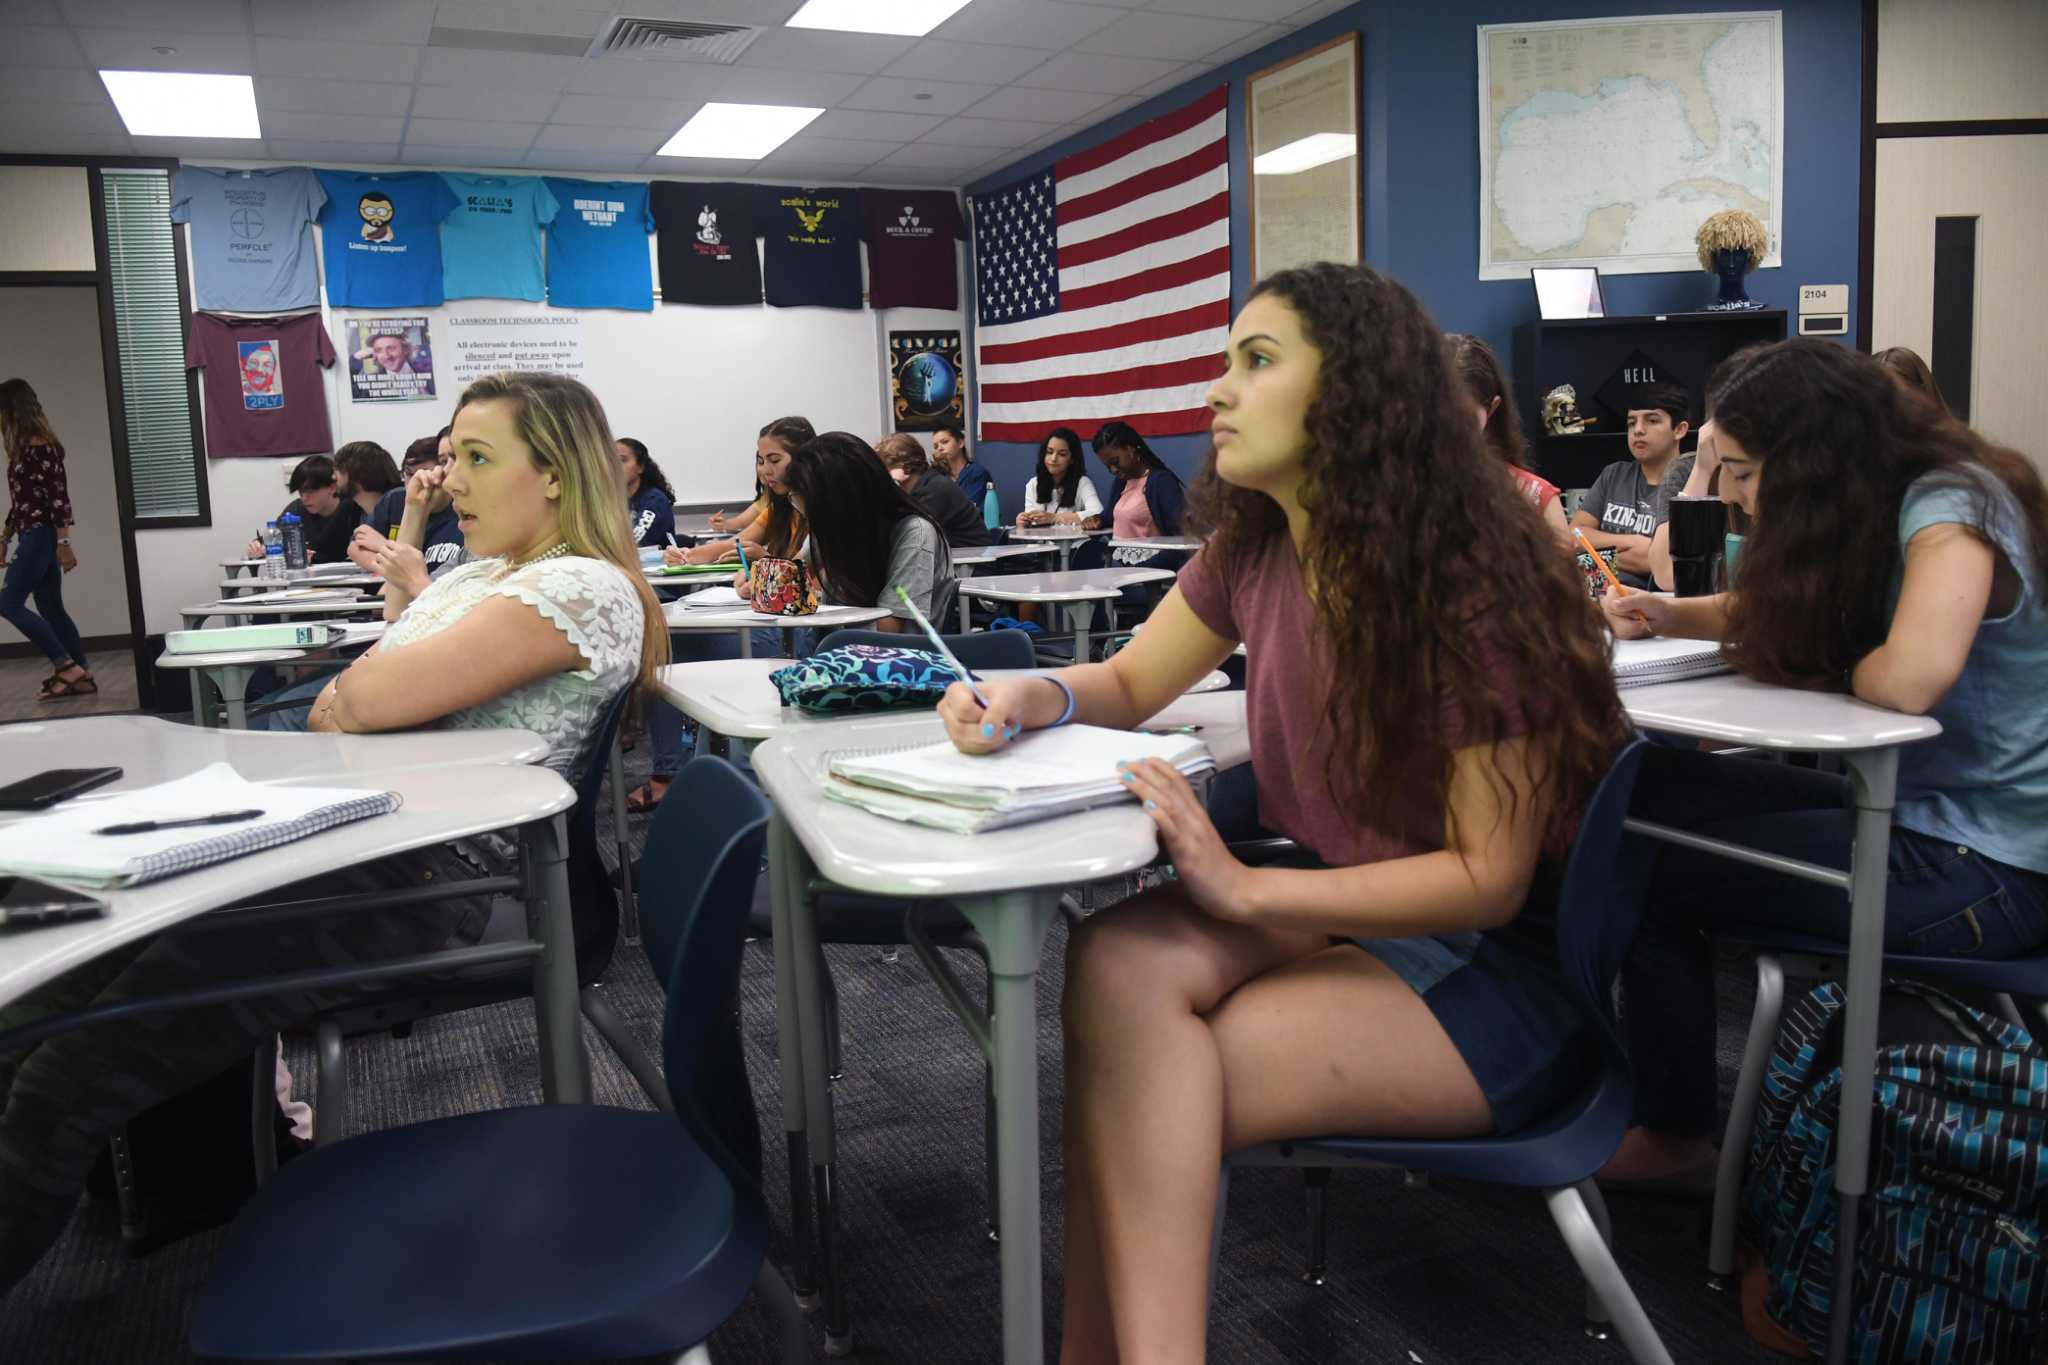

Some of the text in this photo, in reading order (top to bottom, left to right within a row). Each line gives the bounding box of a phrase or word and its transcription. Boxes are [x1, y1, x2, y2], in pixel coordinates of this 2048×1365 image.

[1804, 290, 1827, 299] 2104
[449, 316, 578, 325] CLASSROOM TECHNOLOGY POLICY
[456, 341, 467, 349] All
[469, 341, 507, 349] electronic
[509, 340, 537, 348] devices
[540, 340, 557, 348] need
[465, 352, 496, 360] silenced
[514, 352, 528, 361] put
[453, 363, 481, 371] arrival
[516, 362, 535, 370] They
[566, 361, 583, 369] used
[1624, 367, 1656, 383] HELL
[247, 396, 281, 408] 2PLY
